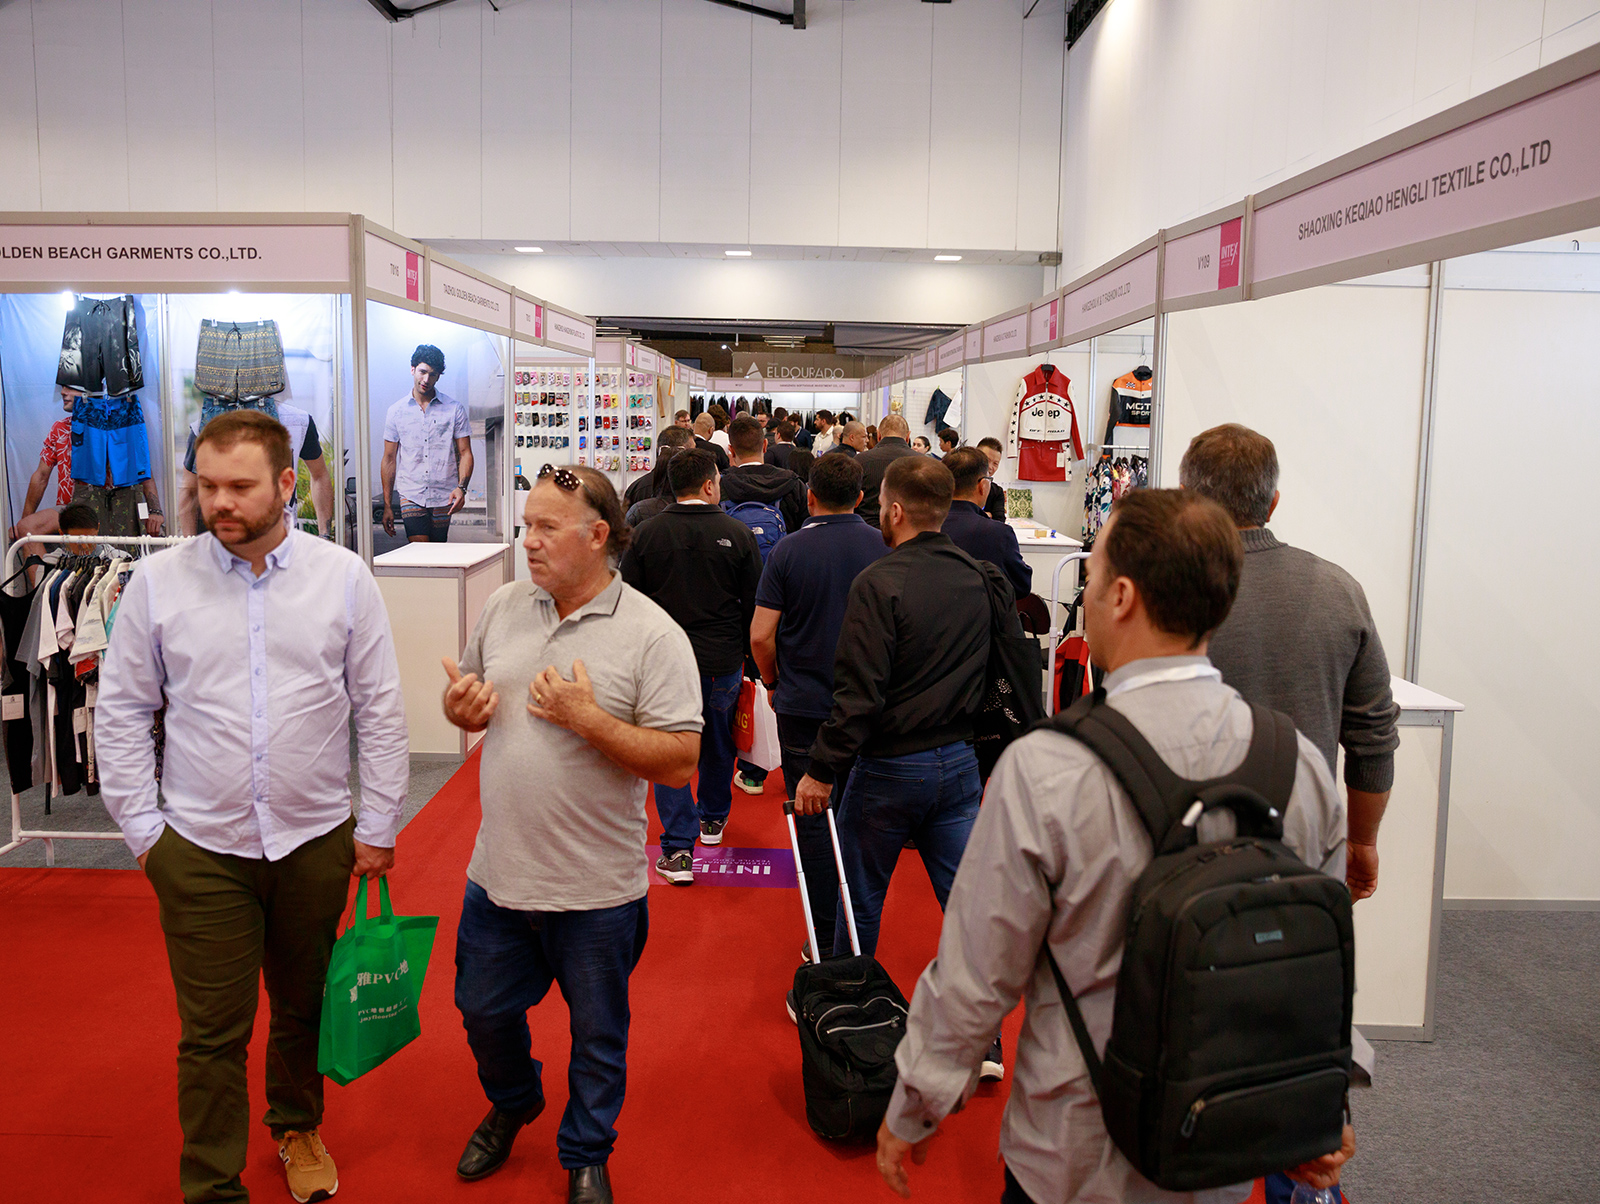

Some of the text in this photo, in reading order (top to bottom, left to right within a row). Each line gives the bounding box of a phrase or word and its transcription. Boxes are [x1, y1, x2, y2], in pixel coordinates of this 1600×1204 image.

[1298, 139, 1552, 241] SHAOXING KEQIAO HENGLI TEXTILE CO.,LTD
[0, 246, 262, 262] LDEN BEACH GARMENTS CO.,LTD.
[1197, 254, 1211, 271] V109
[1221, 242, 1239, 266] INTEX
[691, 863, 771, 875] INTE
